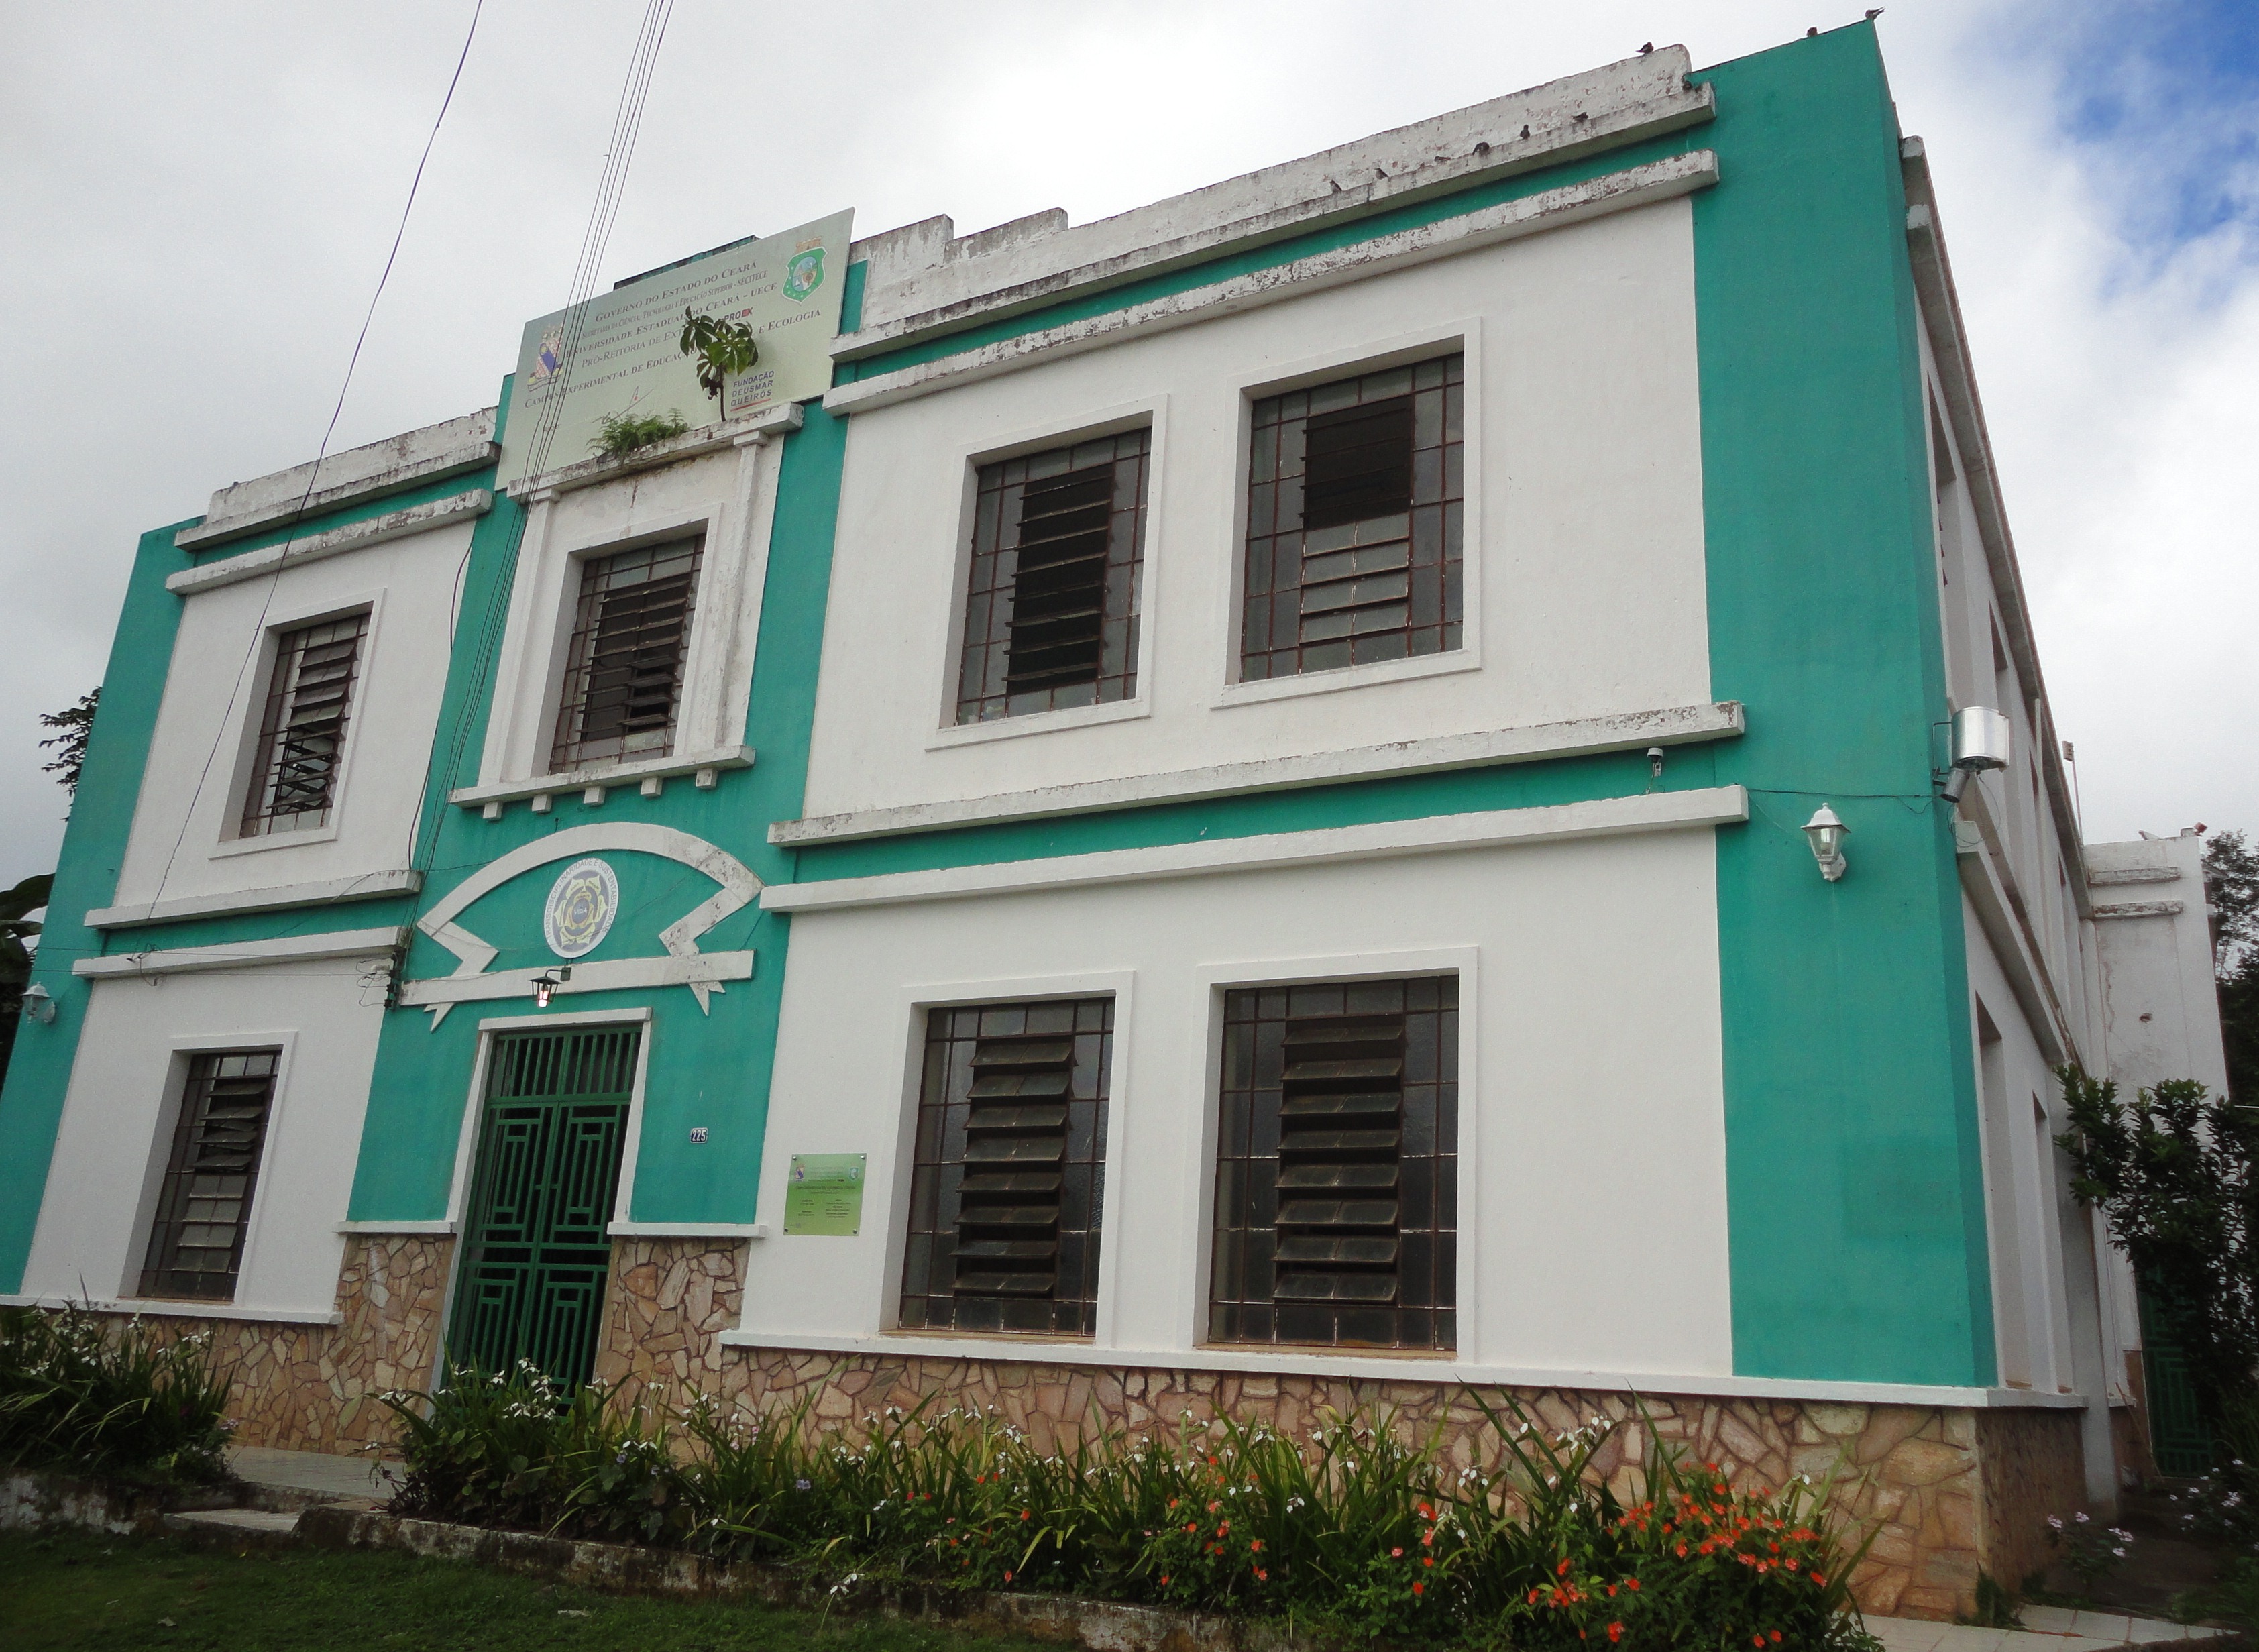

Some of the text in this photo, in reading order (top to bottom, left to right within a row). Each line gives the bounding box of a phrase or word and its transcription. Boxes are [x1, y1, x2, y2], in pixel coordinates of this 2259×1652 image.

[595, 259, 757, 323] GOVERNO DO ESTADO DO CEARÁ
[679, 291, 708, 307] EDUCAÇÃO
[708, 283, 733, 296] SUPERIOR
[738, 270, 768, 286] SECITECE
[636, 313, 685, 335] ESTADUAL
[706, 292, 740, 312] CEARÁ
[750, 282, 778, 298] UECE
[582, 337, 661, 368] PRÓ-REITORIA DE
[631, 364, 643, 375] DE
[646, 347, 697, 370] EDUCAÇO
[767, 309, 821, 331] ECOLOGIA
[732, 380, 773, 398] DEUSMAR
[733, 370, 775, 388] FUNDAÇÃO
[730, 388, 773, 407] QUEIRÓS
[545, 857, 594, 939] TRANSDISCIPLINARIDADE
[598, 861, 618, 934] SUSTENTABILIDADE
[692, 1130, 707, 1142] 225
